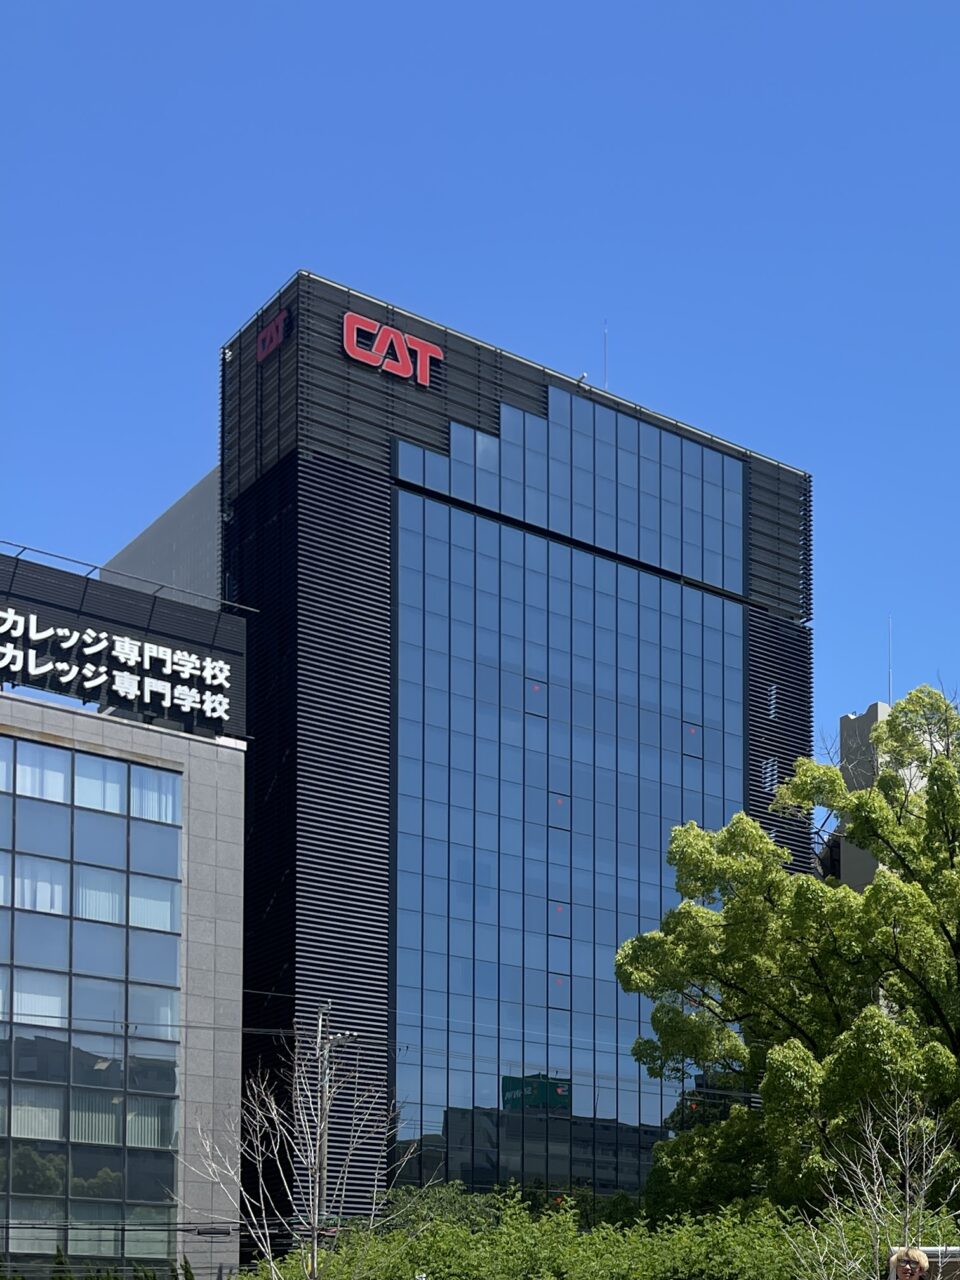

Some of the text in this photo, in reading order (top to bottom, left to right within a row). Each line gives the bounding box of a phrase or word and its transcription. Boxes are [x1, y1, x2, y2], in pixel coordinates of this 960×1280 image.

[257, 309, 288, 362] CAT
[343, 311, 445, 387] CAT
[0, 608, 231, 688] カレッジ専門学校
[0, 643, 230, 721] カレッジ専門学校
